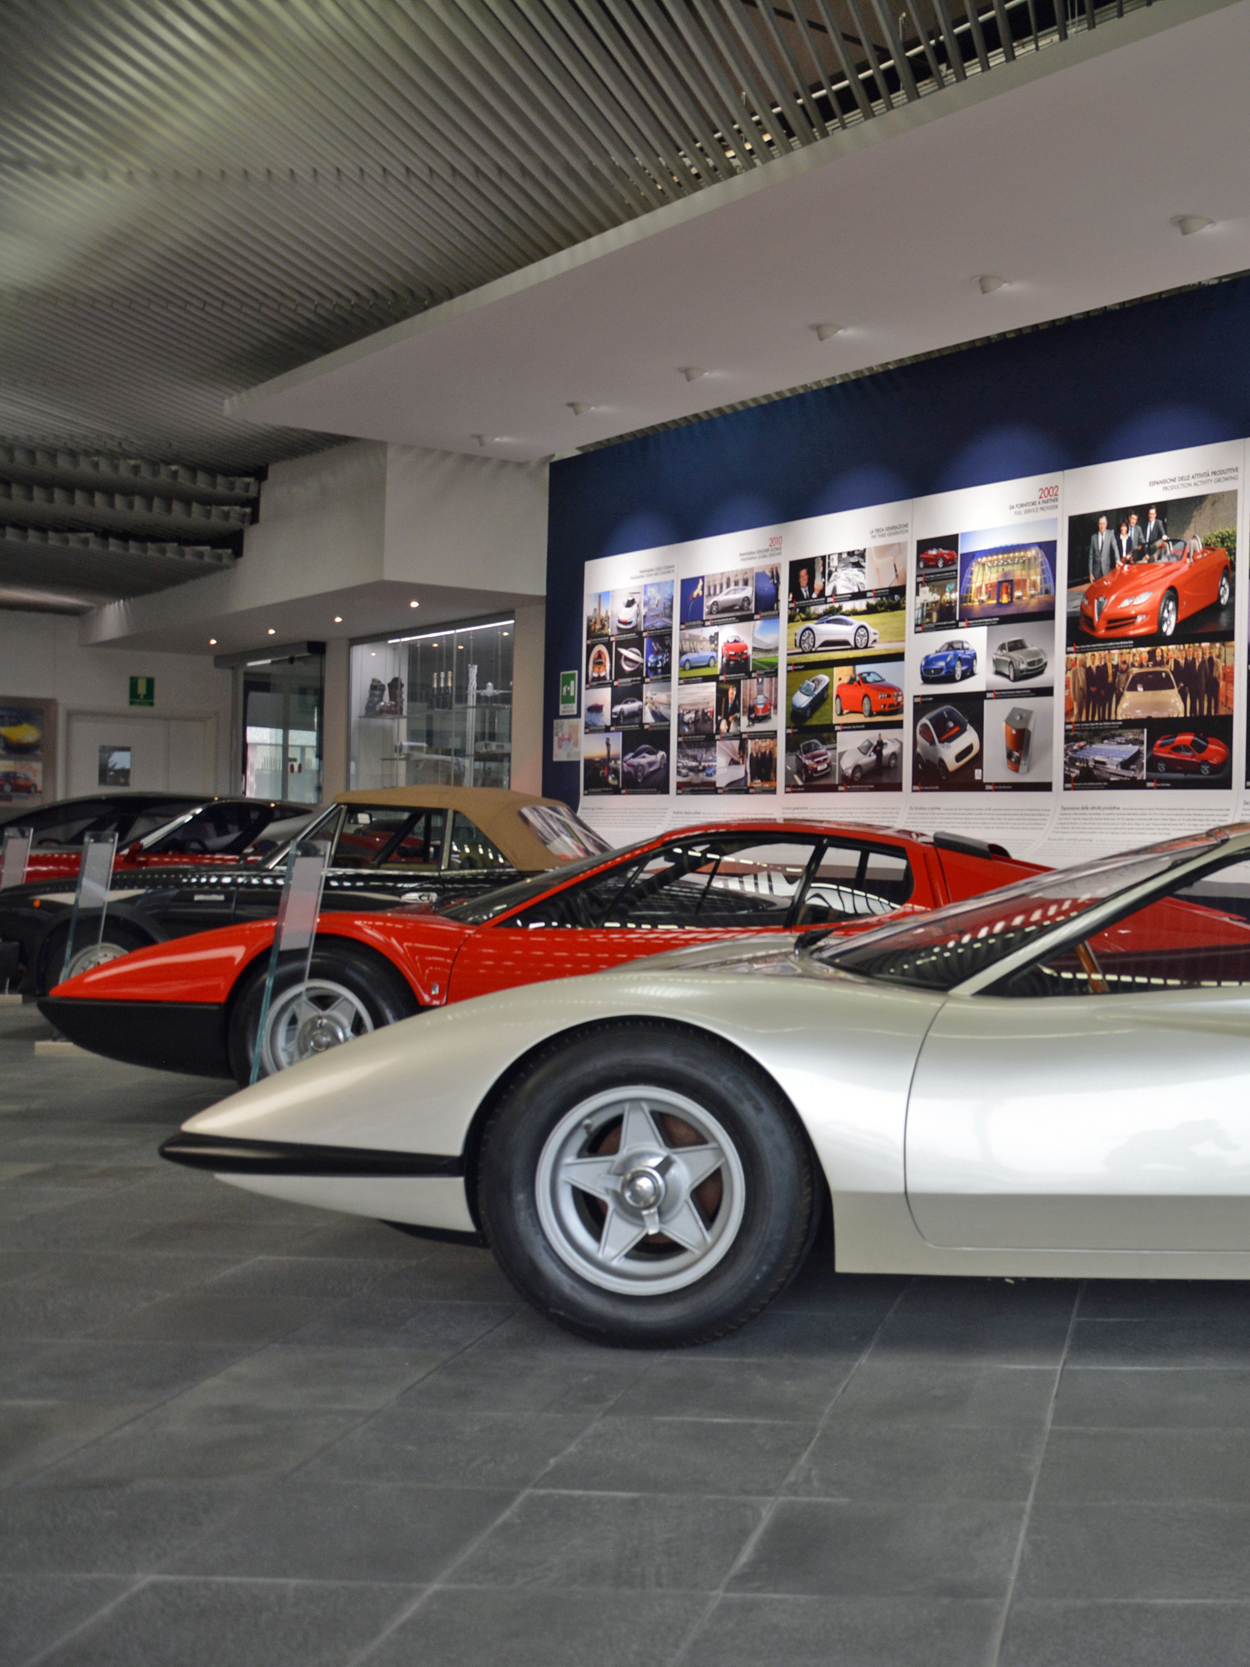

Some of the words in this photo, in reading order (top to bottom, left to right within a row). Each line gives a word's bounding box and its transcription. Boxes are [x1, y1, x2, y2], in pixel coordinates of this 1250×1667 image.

[1149, 477, 1177, 487] ESPANSIONE
[1211, 467, 1239, 476] PRODUTTIVE
[1162, 482, 1192, 491] PRODUCTION
[1193, 479, 1213, 487] ACTIVITY
[1214, 475, 1239, 484] GROWING
[1038, 485, 1059, 499] 2002
[769, 535, 782, 547] 2010
